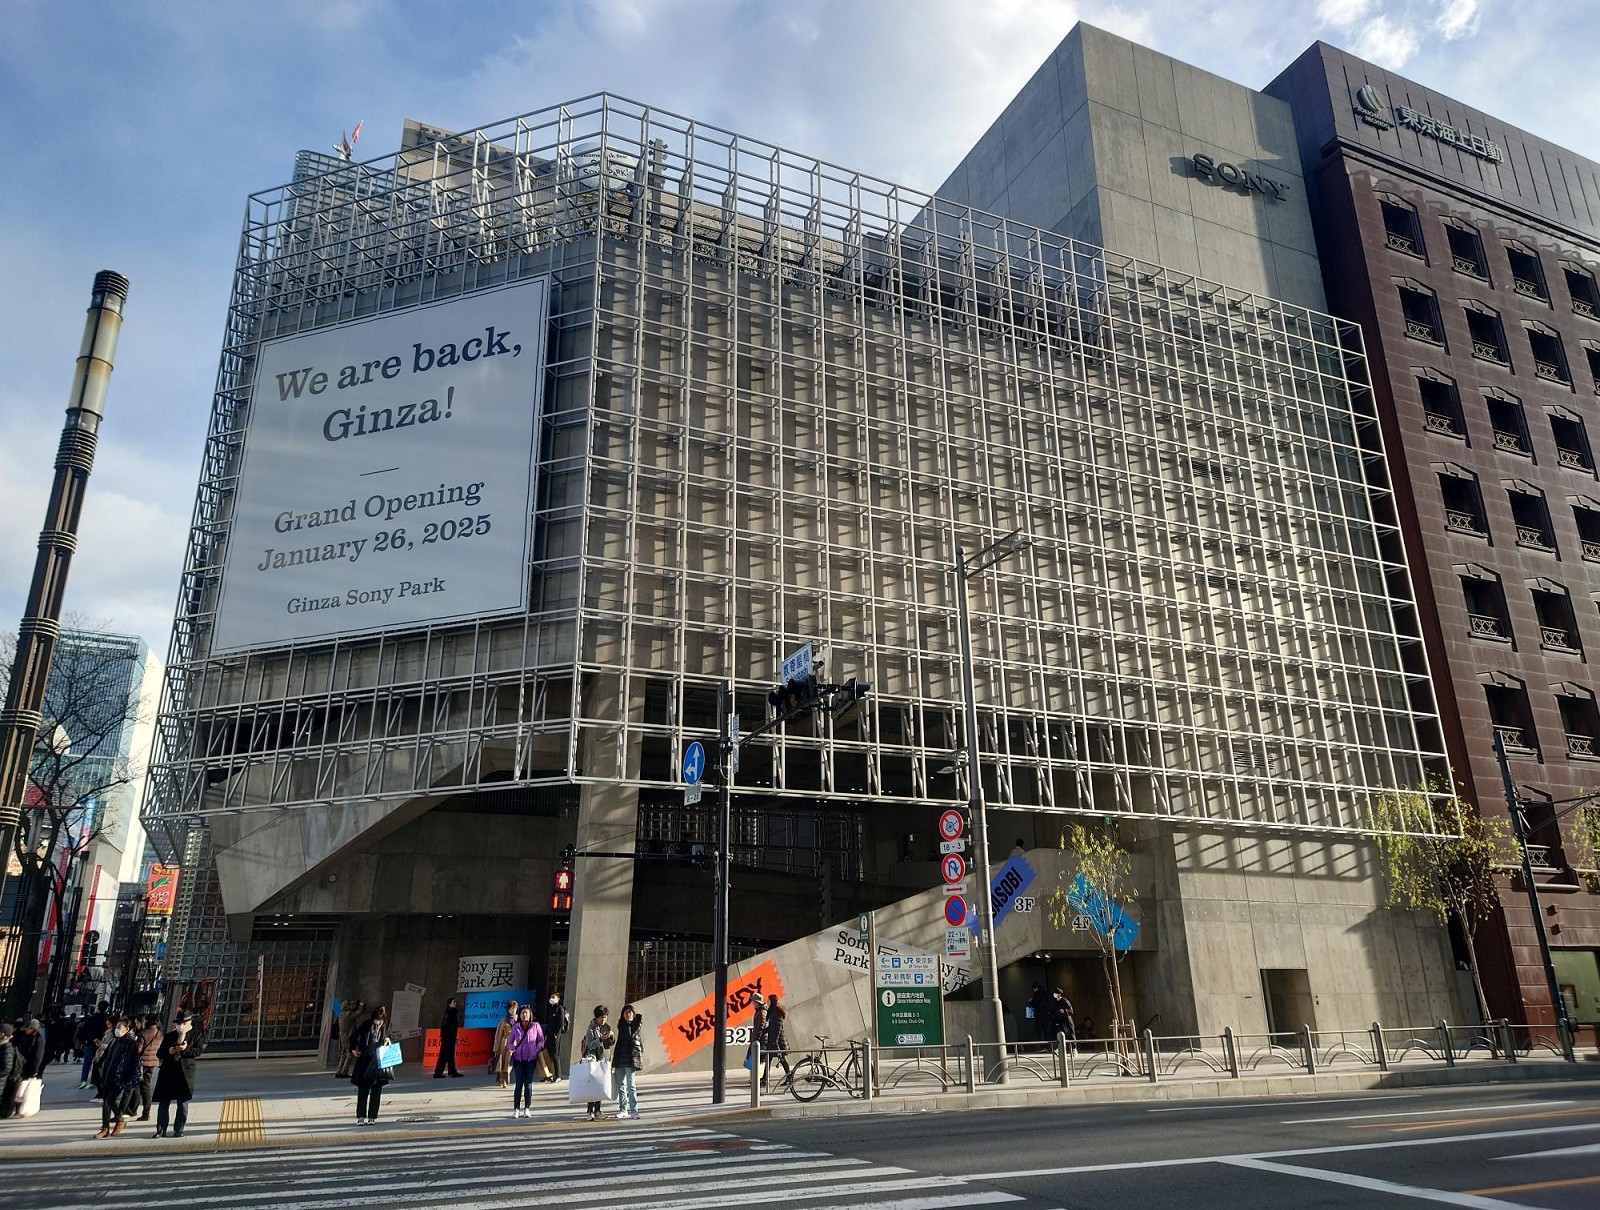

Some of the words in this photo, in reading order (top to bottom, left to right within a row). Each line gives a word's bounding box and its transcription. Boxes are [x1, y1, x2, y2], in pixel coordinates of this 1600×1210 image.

[1399, 105, 1504, 164] 東京海上日動
[1193, 153, 1290, 202] SONY
[276, 366, 328, 401] We
[337, 355, 401, 390] are
[412, 326, 522, 373] back,
[323, 386, 456, 442] Ginza!
[275, 500, 356, 533] Grand
[364, 481, 485, 521] Opening
[258, 535, 368, 572] January
[372, 528, 414, 553] 26,
[422, 513, 492, 545] 2025
[287, 594, 341, 615] Ginza
[345, 586, 395, 607] Sony
[399, 577, 446, 598] Park
[992, 866, 1024, 918] ASOBI
[1015, 898, 1034, 912] 3F
[1073, 915, 1091, 929] 4F
[461, 960, 488, 975] Sony
[487, 961, 514, 987] 展
[834, 948, 870, 969] Park
[460, 976, 485, 988] Park
